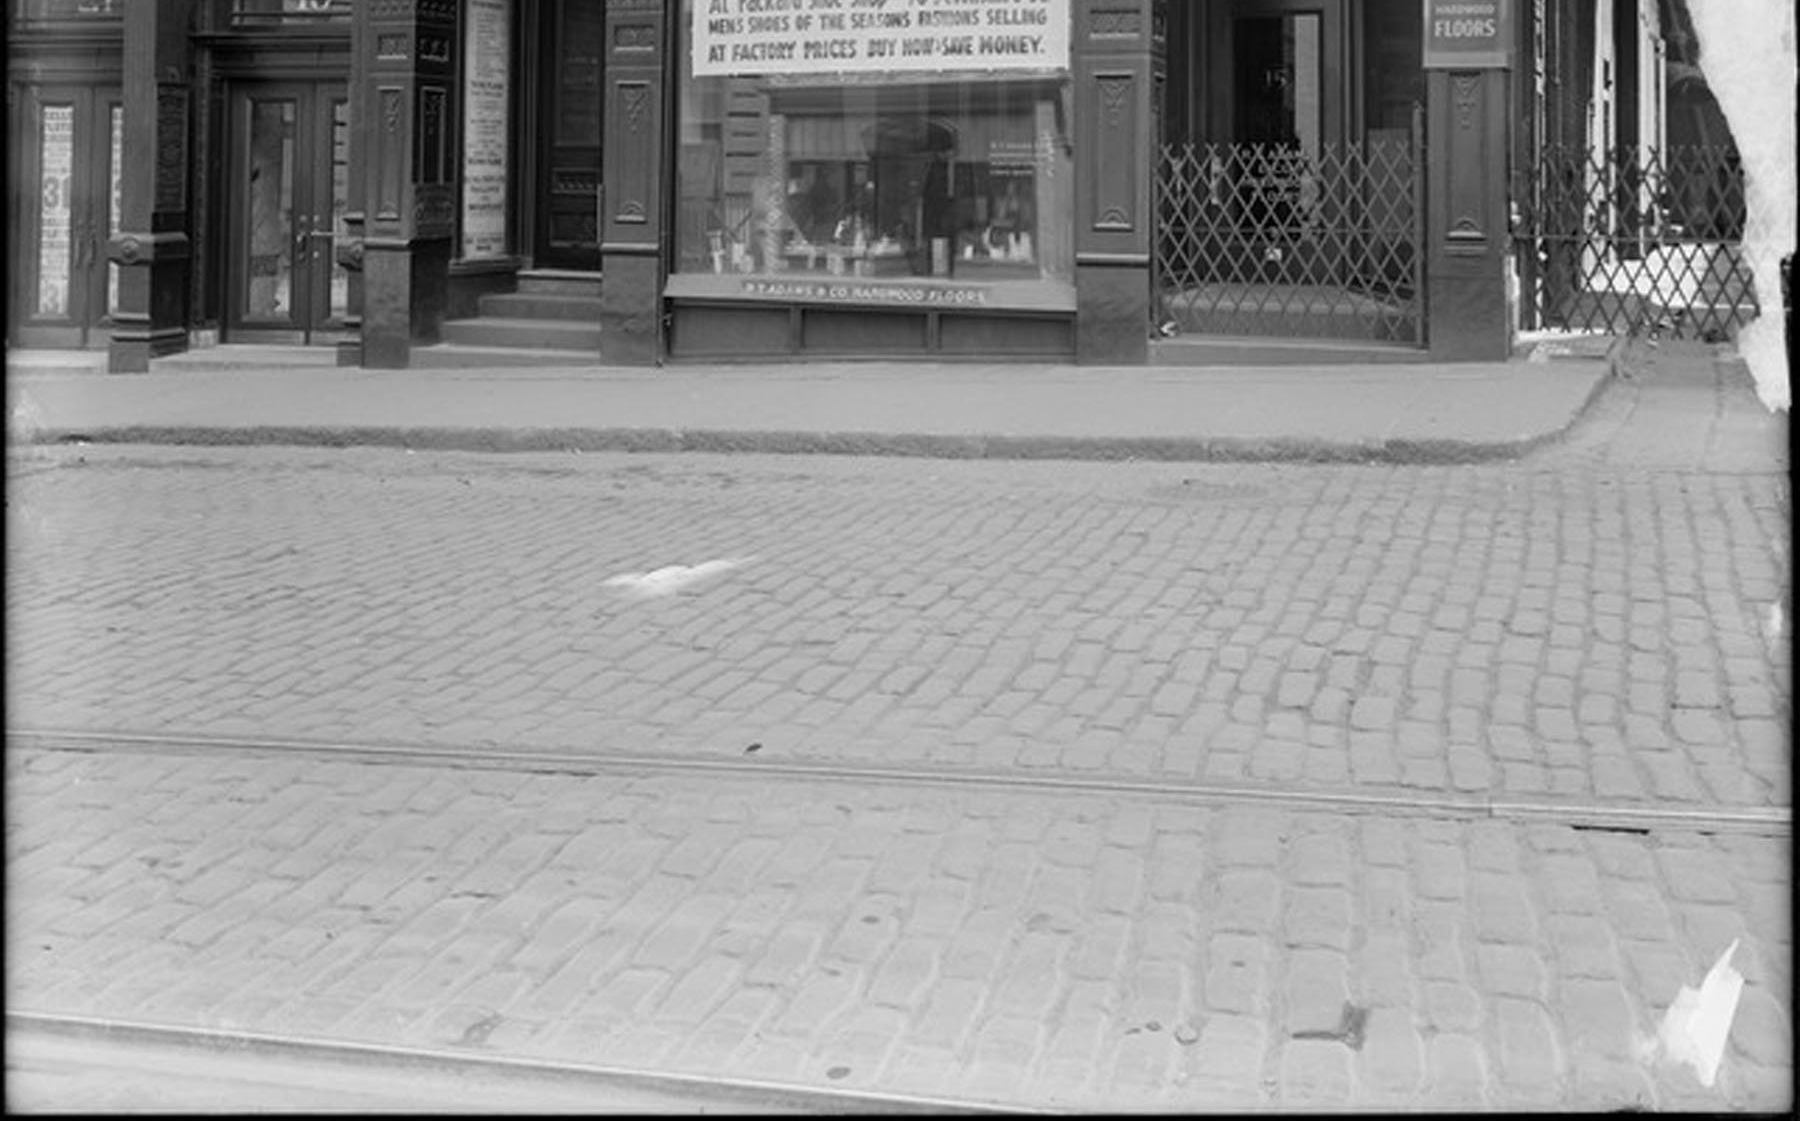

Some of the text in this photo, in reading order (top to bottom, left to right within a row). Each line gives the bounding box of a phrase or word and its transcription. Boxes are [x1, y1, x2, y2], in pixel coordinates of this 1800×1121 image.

[747, 15, 790, 34] SHOES
[795, 14, 813, 31] OF
[819, 12, 847, 31] THE
[850, 10, 911, 29] SEASONS
[918, 8, 980, 27] FASHIONS
[986, 7, 1048, 26] SELLING
[1434, 18, 1497, 38] FLOORS
[708, 43, 727, 64] AT
[731, 40, 797, 62] FACTORY
[803, 38, 858, 60] PRICES
[867, 37, 897, 57] BUY
